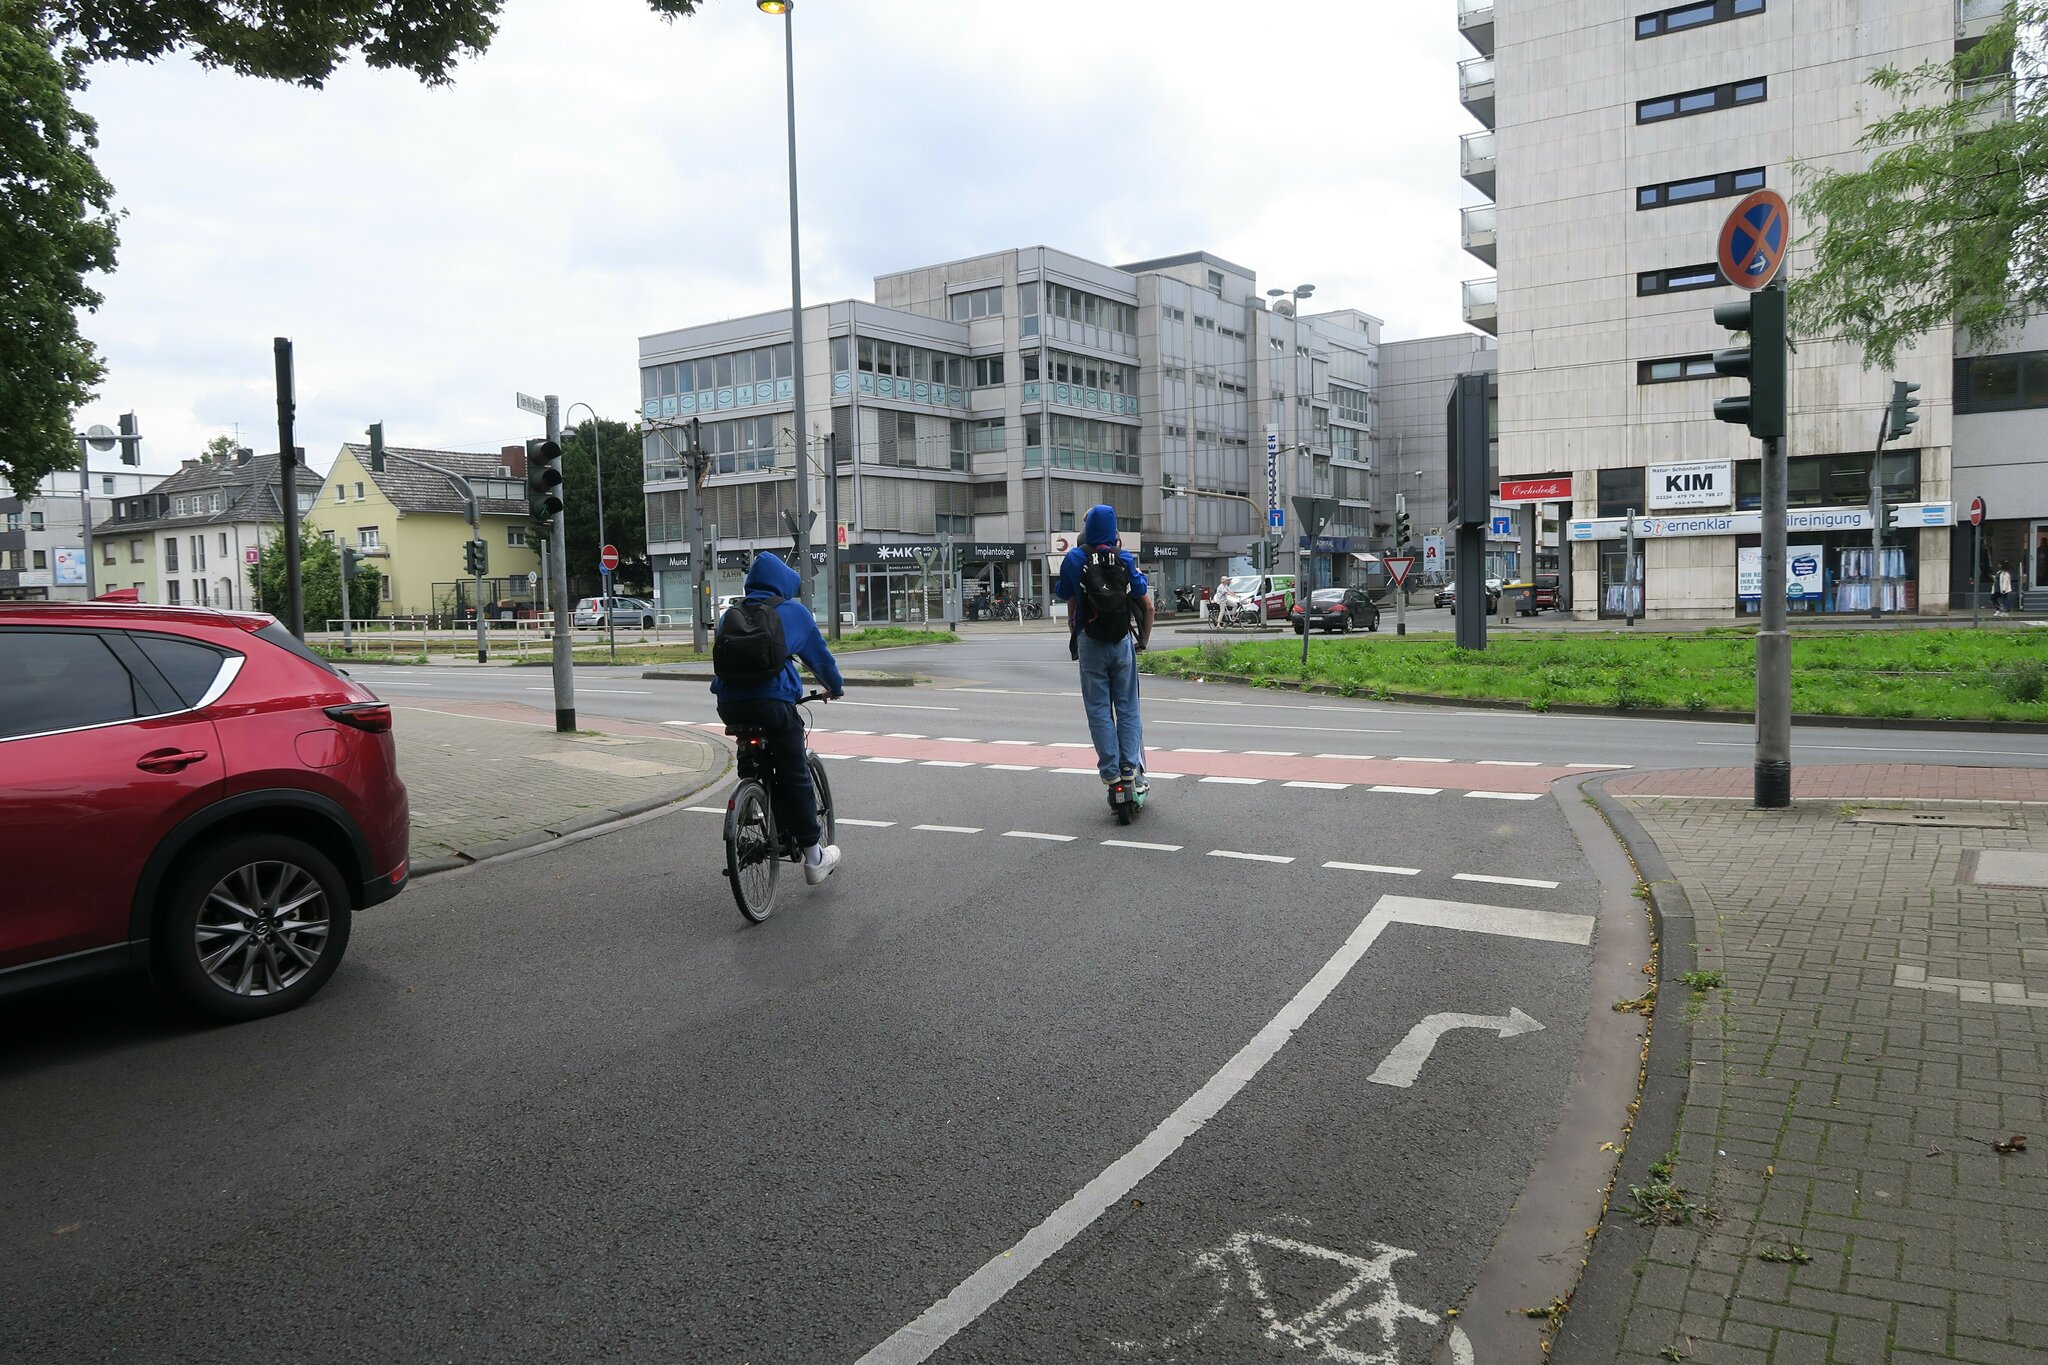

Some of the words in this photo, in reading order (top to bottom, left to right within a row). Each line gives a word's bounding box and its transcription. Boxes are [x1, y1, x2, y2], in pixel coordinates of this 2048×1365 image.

[1666, 473, 1713, 492] KIM
[1643, 518, 1732, 533] Sternenklar
[1787, 513, 1861, 527] ilreinigung
[975, 545, 1015, 559] Implantologie
[1160, 547, 1172, 555] MKG
[669, 557, 688, 566] Mund
[722, 571, 742, 579] ZAHN
